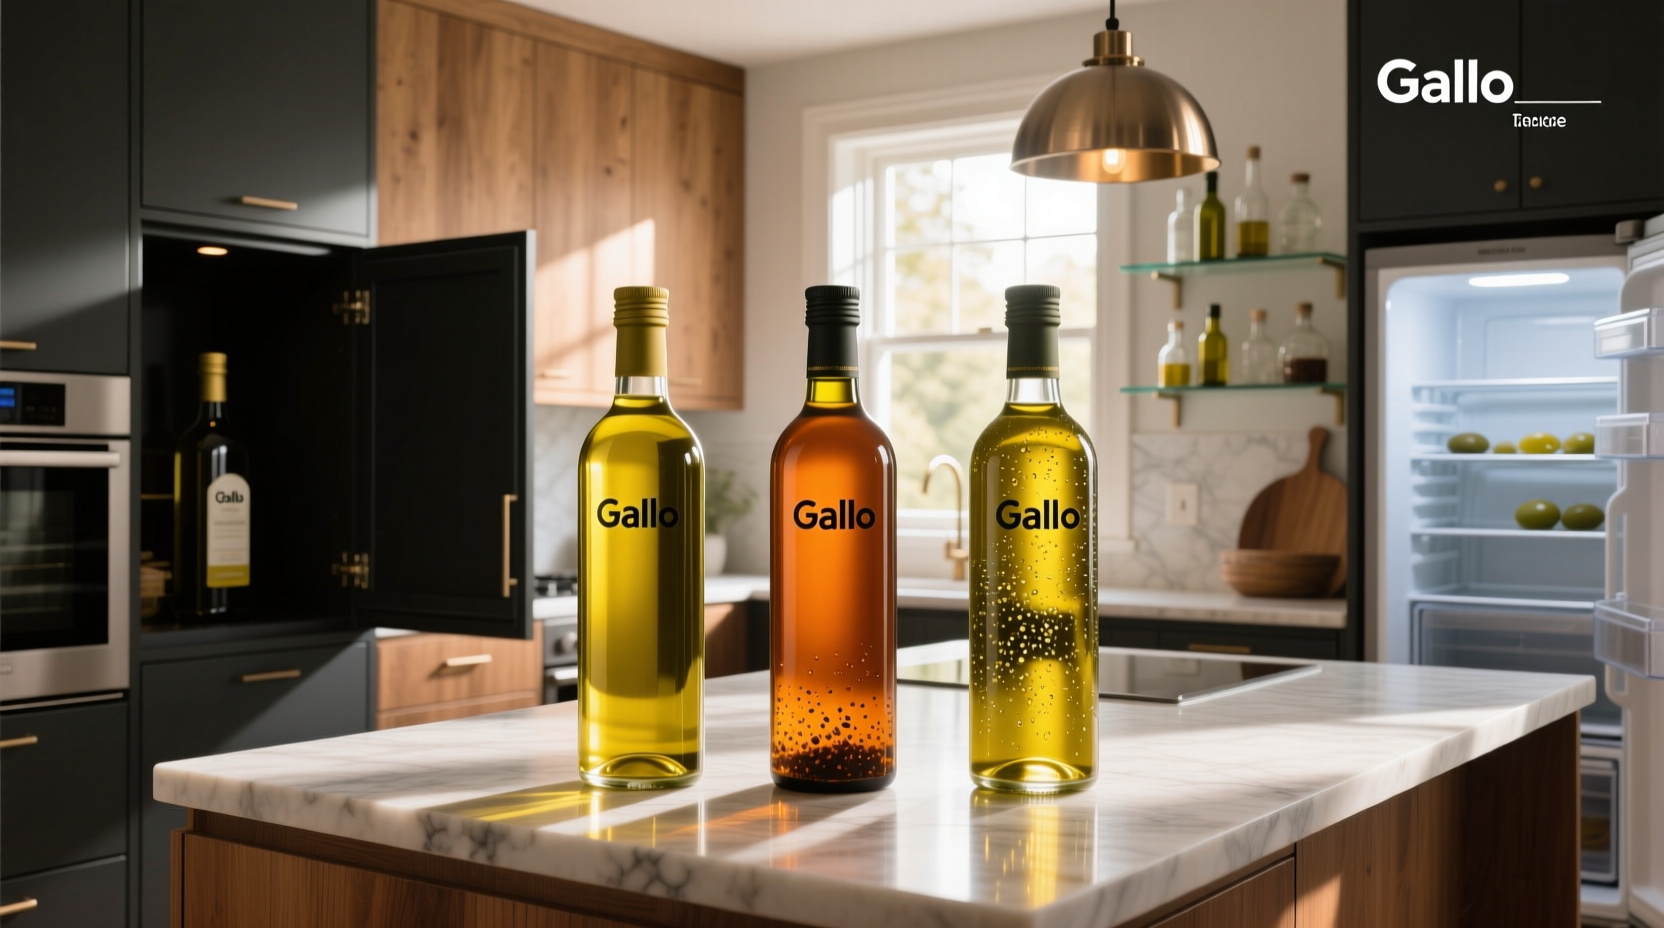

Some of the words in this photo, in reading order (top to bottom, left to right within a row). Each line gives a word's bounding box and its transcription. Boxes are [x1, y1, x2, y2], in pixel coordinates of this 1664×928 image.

[596, 498, 679, 529] Gallo
[793, 499, 876, 530] Gallo
[995, 499, 1081, 530] Gallo
